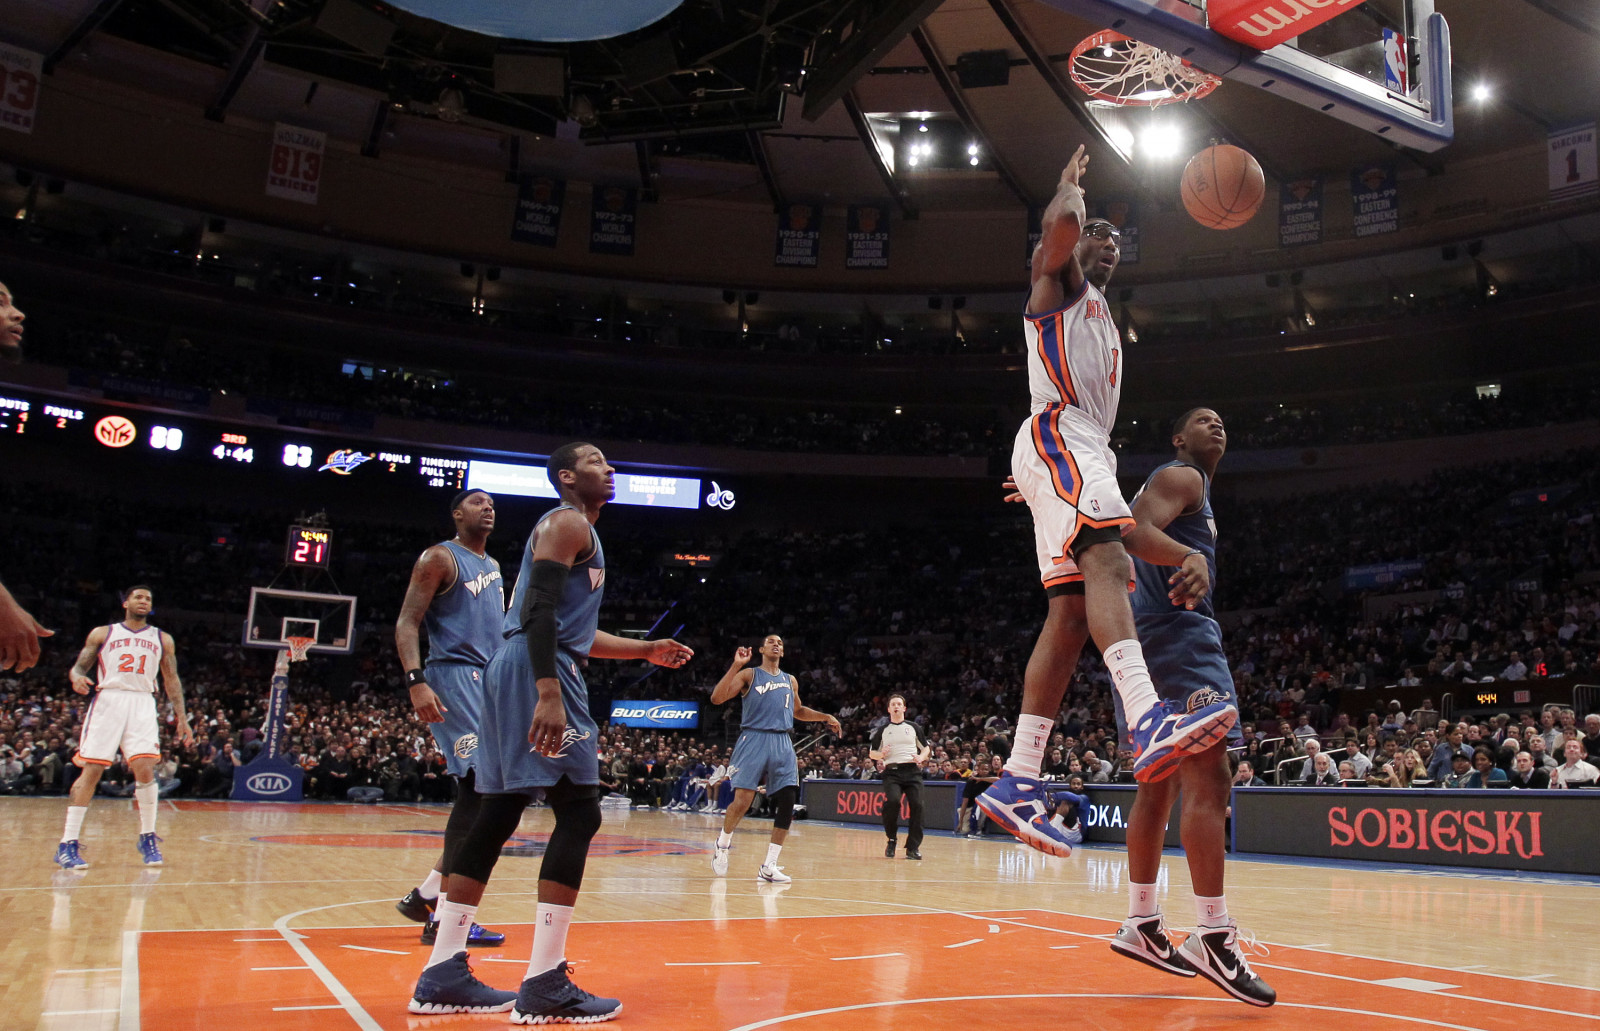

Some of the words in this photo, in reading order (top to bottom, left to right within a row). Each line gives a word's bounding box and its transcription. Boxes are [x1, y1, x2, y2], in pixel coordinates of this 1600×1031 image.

[0, 64, 38, 110] 3
[271, 144, 321, 182] 613
[1565, 149, 1580, 184] 1
[269, 175, 317, 193] KNICKS
[1352, 188, 1397, 204] 1998-99
[1360, 200, 1391, 213] EASTERN
[525, 211, 551, 225] WORLD
[1286, 212, 1315, 224] EASTERN
[1353, 208, 1398, 226] CONFERENCE
[516, 220, 556, 236] CHAMPIONS
[600, 222, 626, 234] WORLD
[1355, 220, 1397, 237] CHAMPIONS
[592, 232, 632, 245] CHAMPIONS
[779, 230, 819, 240] 1950-51
[847, 232, 889, 241] 1951-52
[1282, 231, 1320, 245] CHAMPIONS
[782, 239, 813, 248] EASTERN
[852, 241, 883, 249] EASTERN
[782, 247, 812, 257] DIVISION
[852, 249, 882, 258] DIVISION
[775, 256, 817, 266] CHAMPIONS
[846, 257, 888, 267] CHAMPIONS
[18, 411, 28, 422] 4
[44, 404, 85, 420] FOULS
[16, 422, 25, 433] 1
[56, 417, 67, 429] 2
[221, 432, 247, 445] 3RD
[212, 444, 254, 463] 4:44
[379, 452, 411, 464] FOULS
[388, 462, 397, 472] 2
[420, 456, 468, 470] TIMEOUTS
[420, 466, 445, 477] FULL
[457, 469, 465, 479] 3
[456, 480, 462, 489] 1
[301, 530, 328, 543] 4:44
[294, 541, 324, 563] 21
[109, 637, 131, 653] NEW
[134, 637, 160, 656] YORK
[118, 653, 147, 675] 21
[784, 693, 791, 709] 1
[1477, 693, 1497, 705] 4:44
[254, 777, 285, 791] KIA
[1327, 806, 1545, 860] SOBIESKI
